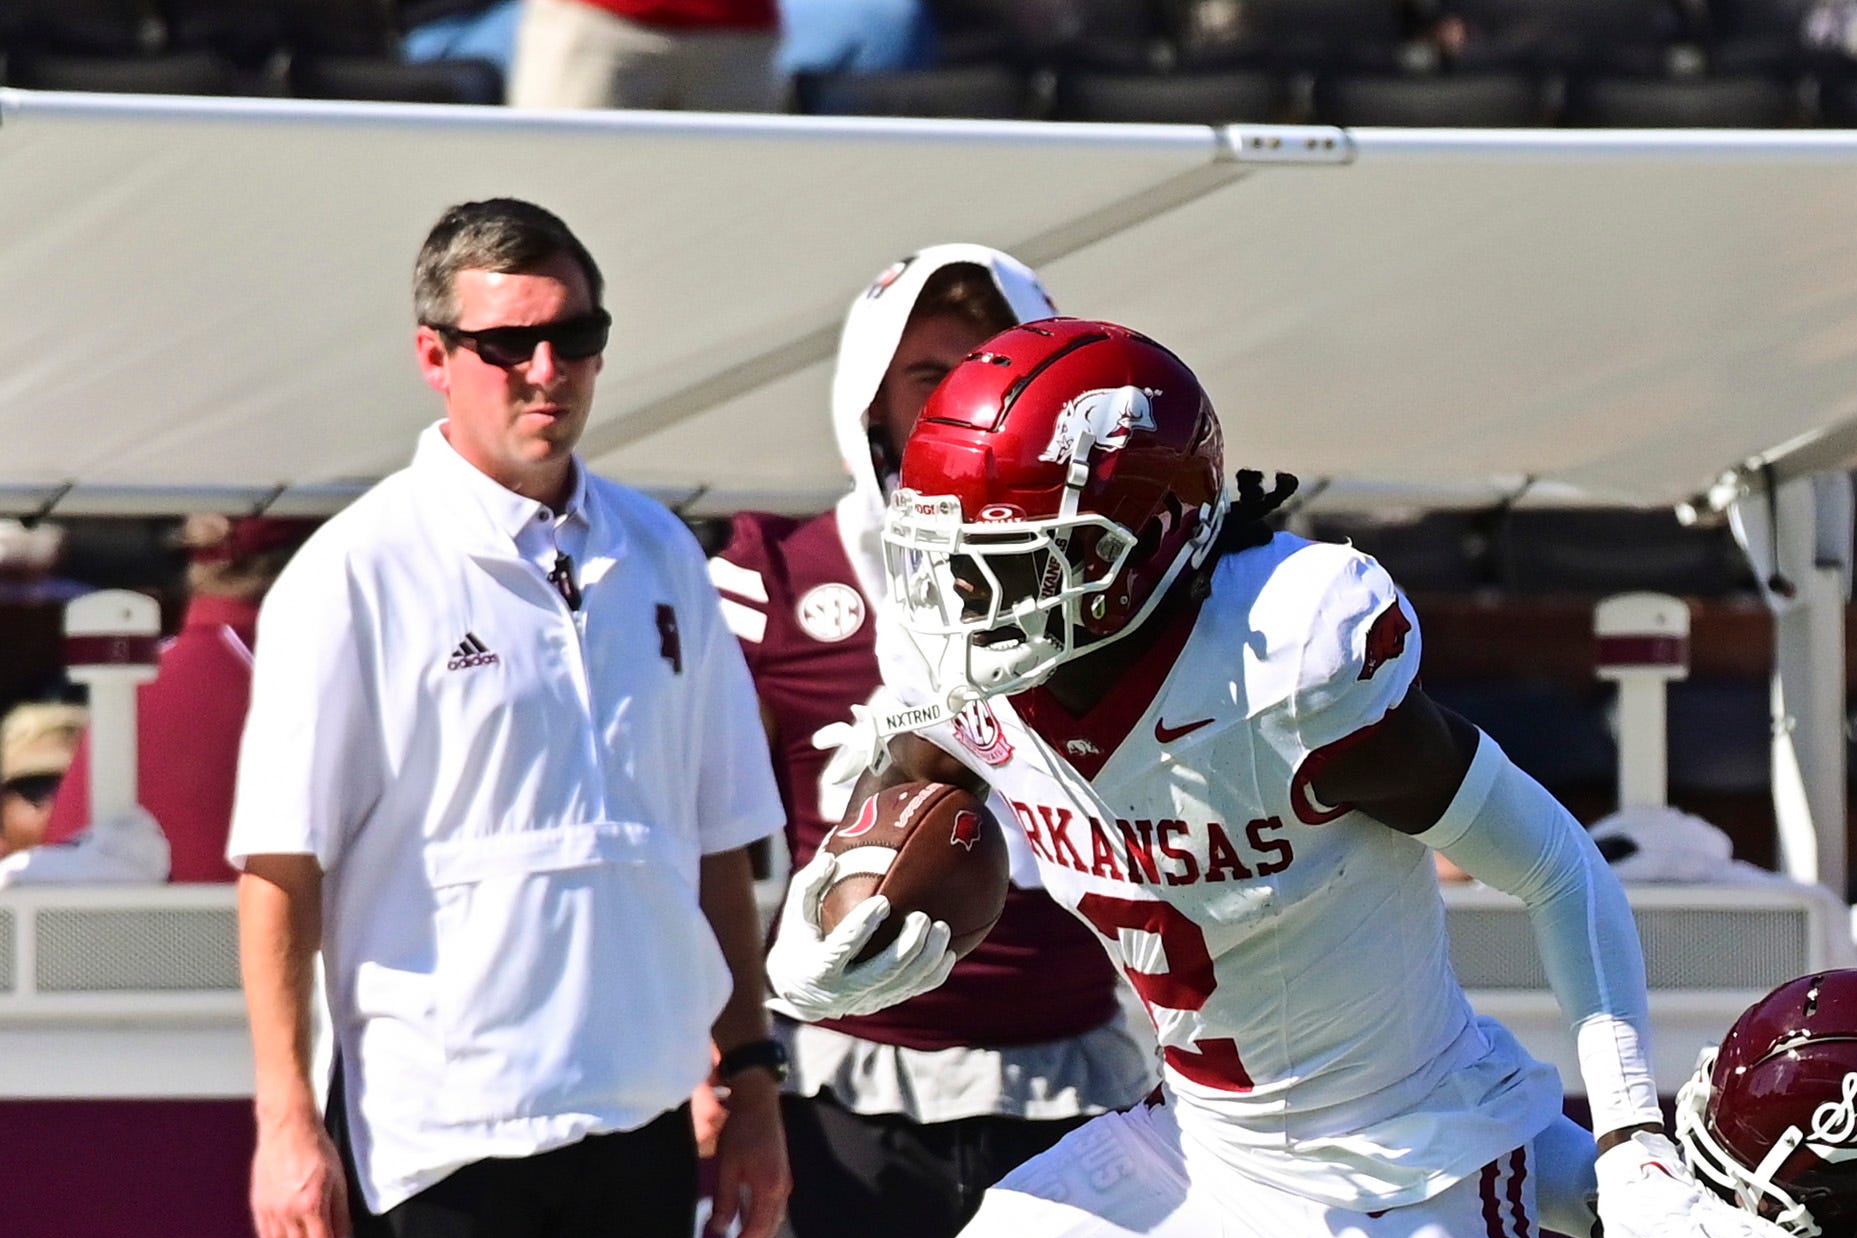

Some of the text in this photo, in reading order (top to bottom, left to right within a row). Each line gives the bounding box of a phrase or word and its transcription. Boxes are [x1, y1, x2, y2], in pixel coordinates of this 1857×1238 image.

[802, 586, 862, 640] SEC
[448, 653, 499, 671] adidas
[886, 704, 941, 730] NXTRND
[1009, 797, 1294, 887] RKANSAS
[1076, 891, 1255, 1093] 2
